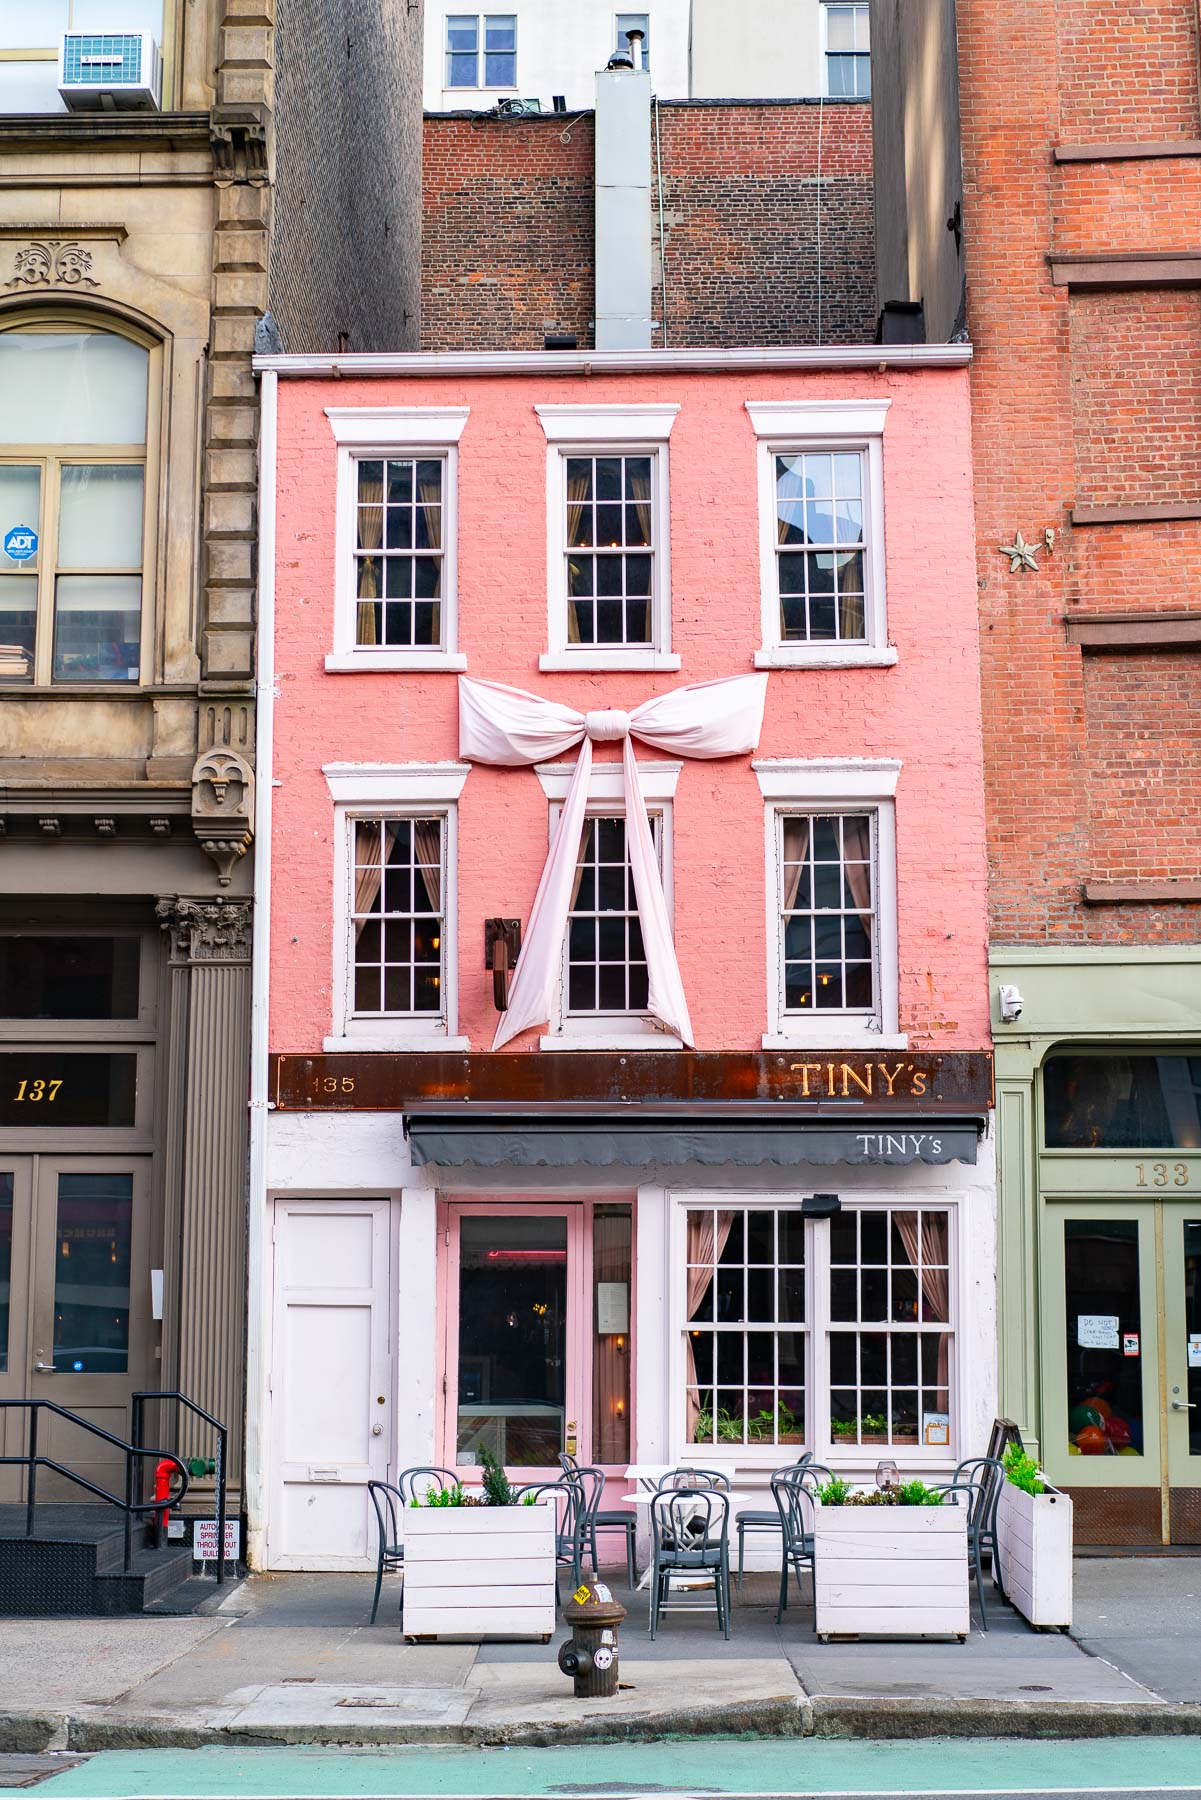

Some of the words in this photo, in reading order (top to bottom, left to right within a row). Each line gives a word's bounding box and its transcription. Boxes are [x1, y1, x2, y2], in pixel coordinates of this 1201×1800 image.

[7, 535, 36, 549] ADT
[313, 1077, 355, 1092] 135
[791, 1063, 927, 1096] TINY's
[13, 1079, 64, 1101] 137
[856, 1134, 942, 1155] TINY's
[1135, 1163, 1189, 1187] 133
[199, 1523, 234, 1531] AUTOTIC
[200, 1531, 233, 1539] SPRINER
[196, 1541, 237, 1549] THROUOUT
